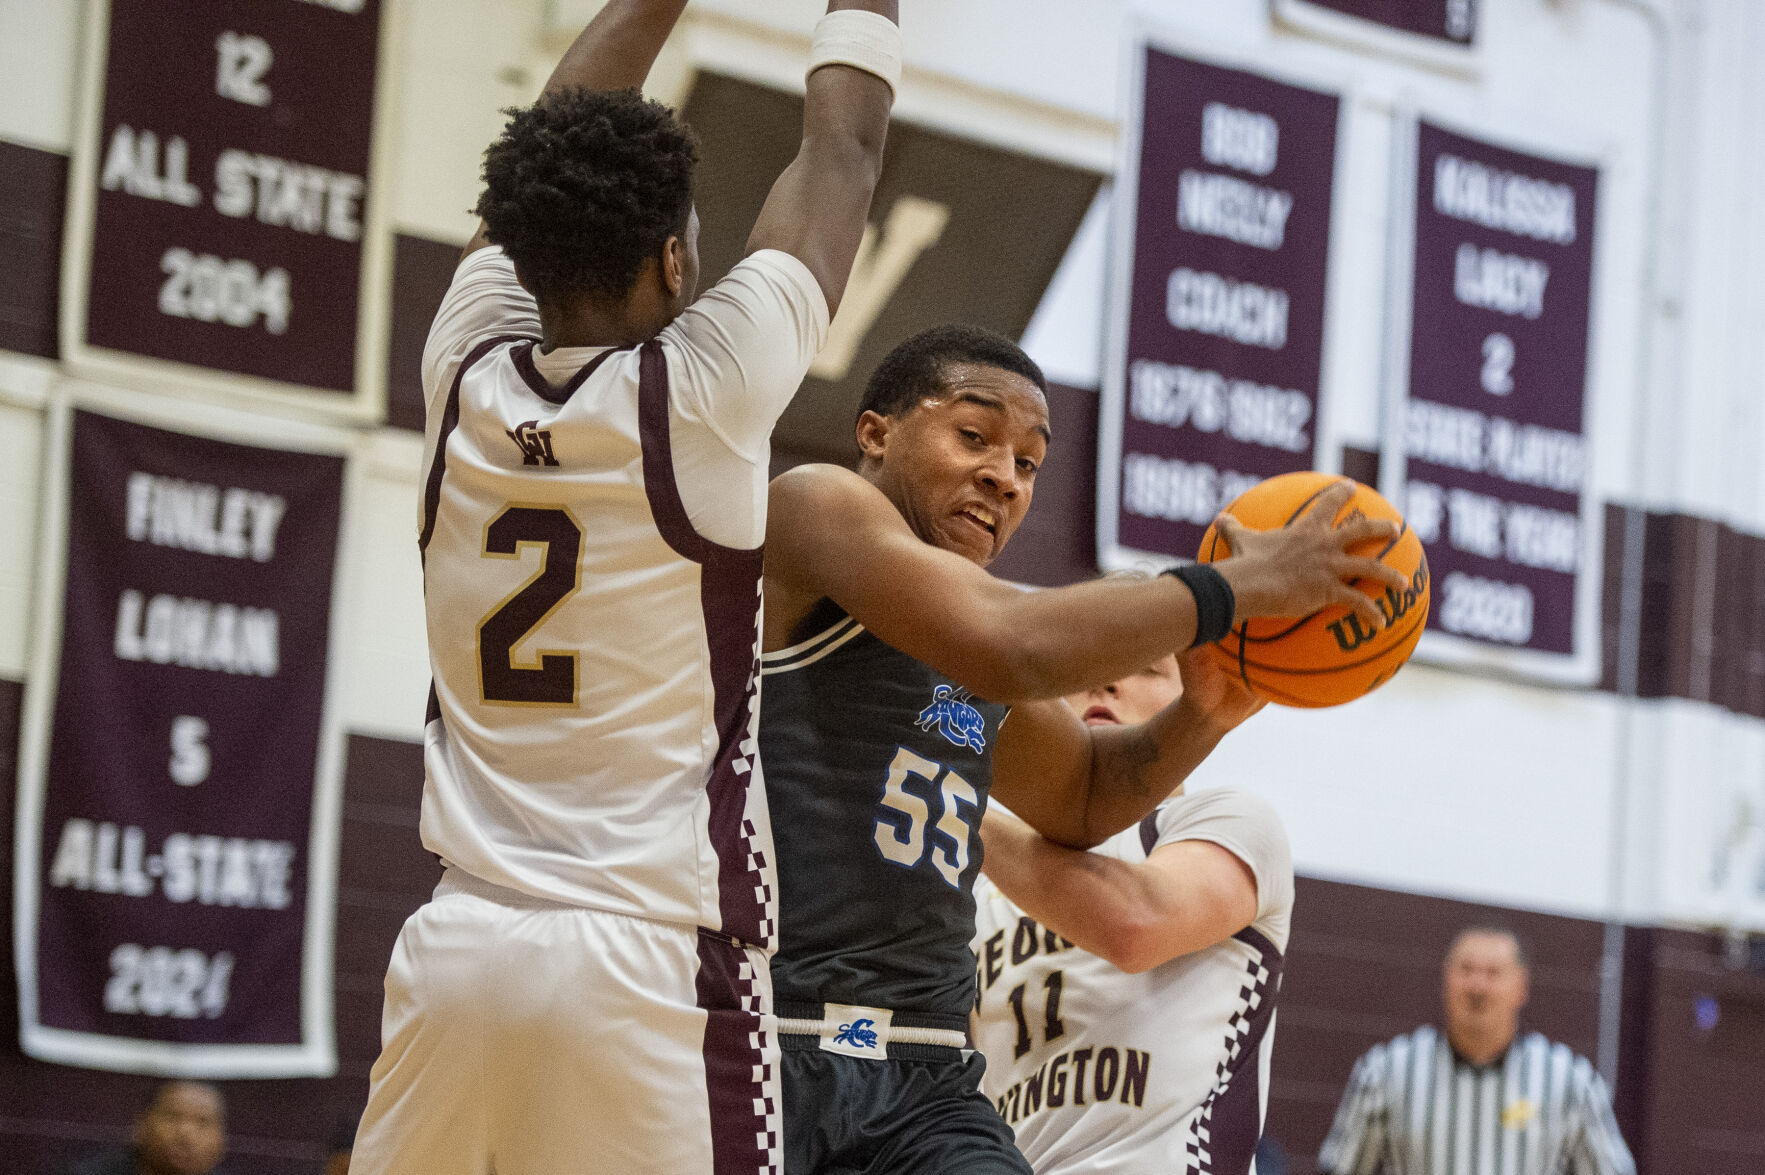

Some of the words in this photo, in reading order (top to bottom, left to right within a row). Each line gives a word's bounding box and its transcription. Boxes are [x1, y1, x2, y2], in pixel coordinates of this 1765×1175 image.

[214, 30, 274, 107] 12
[102, 123, 201, 207] ALL
[213, 148, 370, 243] STATE
[158, 247, 292, 335] 2004
[1166, 266, 1290, 351] COACH
[1480, 332, 1516, 397] 2
[126, 471, 286, 563] FINLEY
[475, 500, 588, 711] 2
[169, 714, 211, 787] 5
[873, 744, 979, 891] 55
[1007, 970, 1065, 1064] 11
